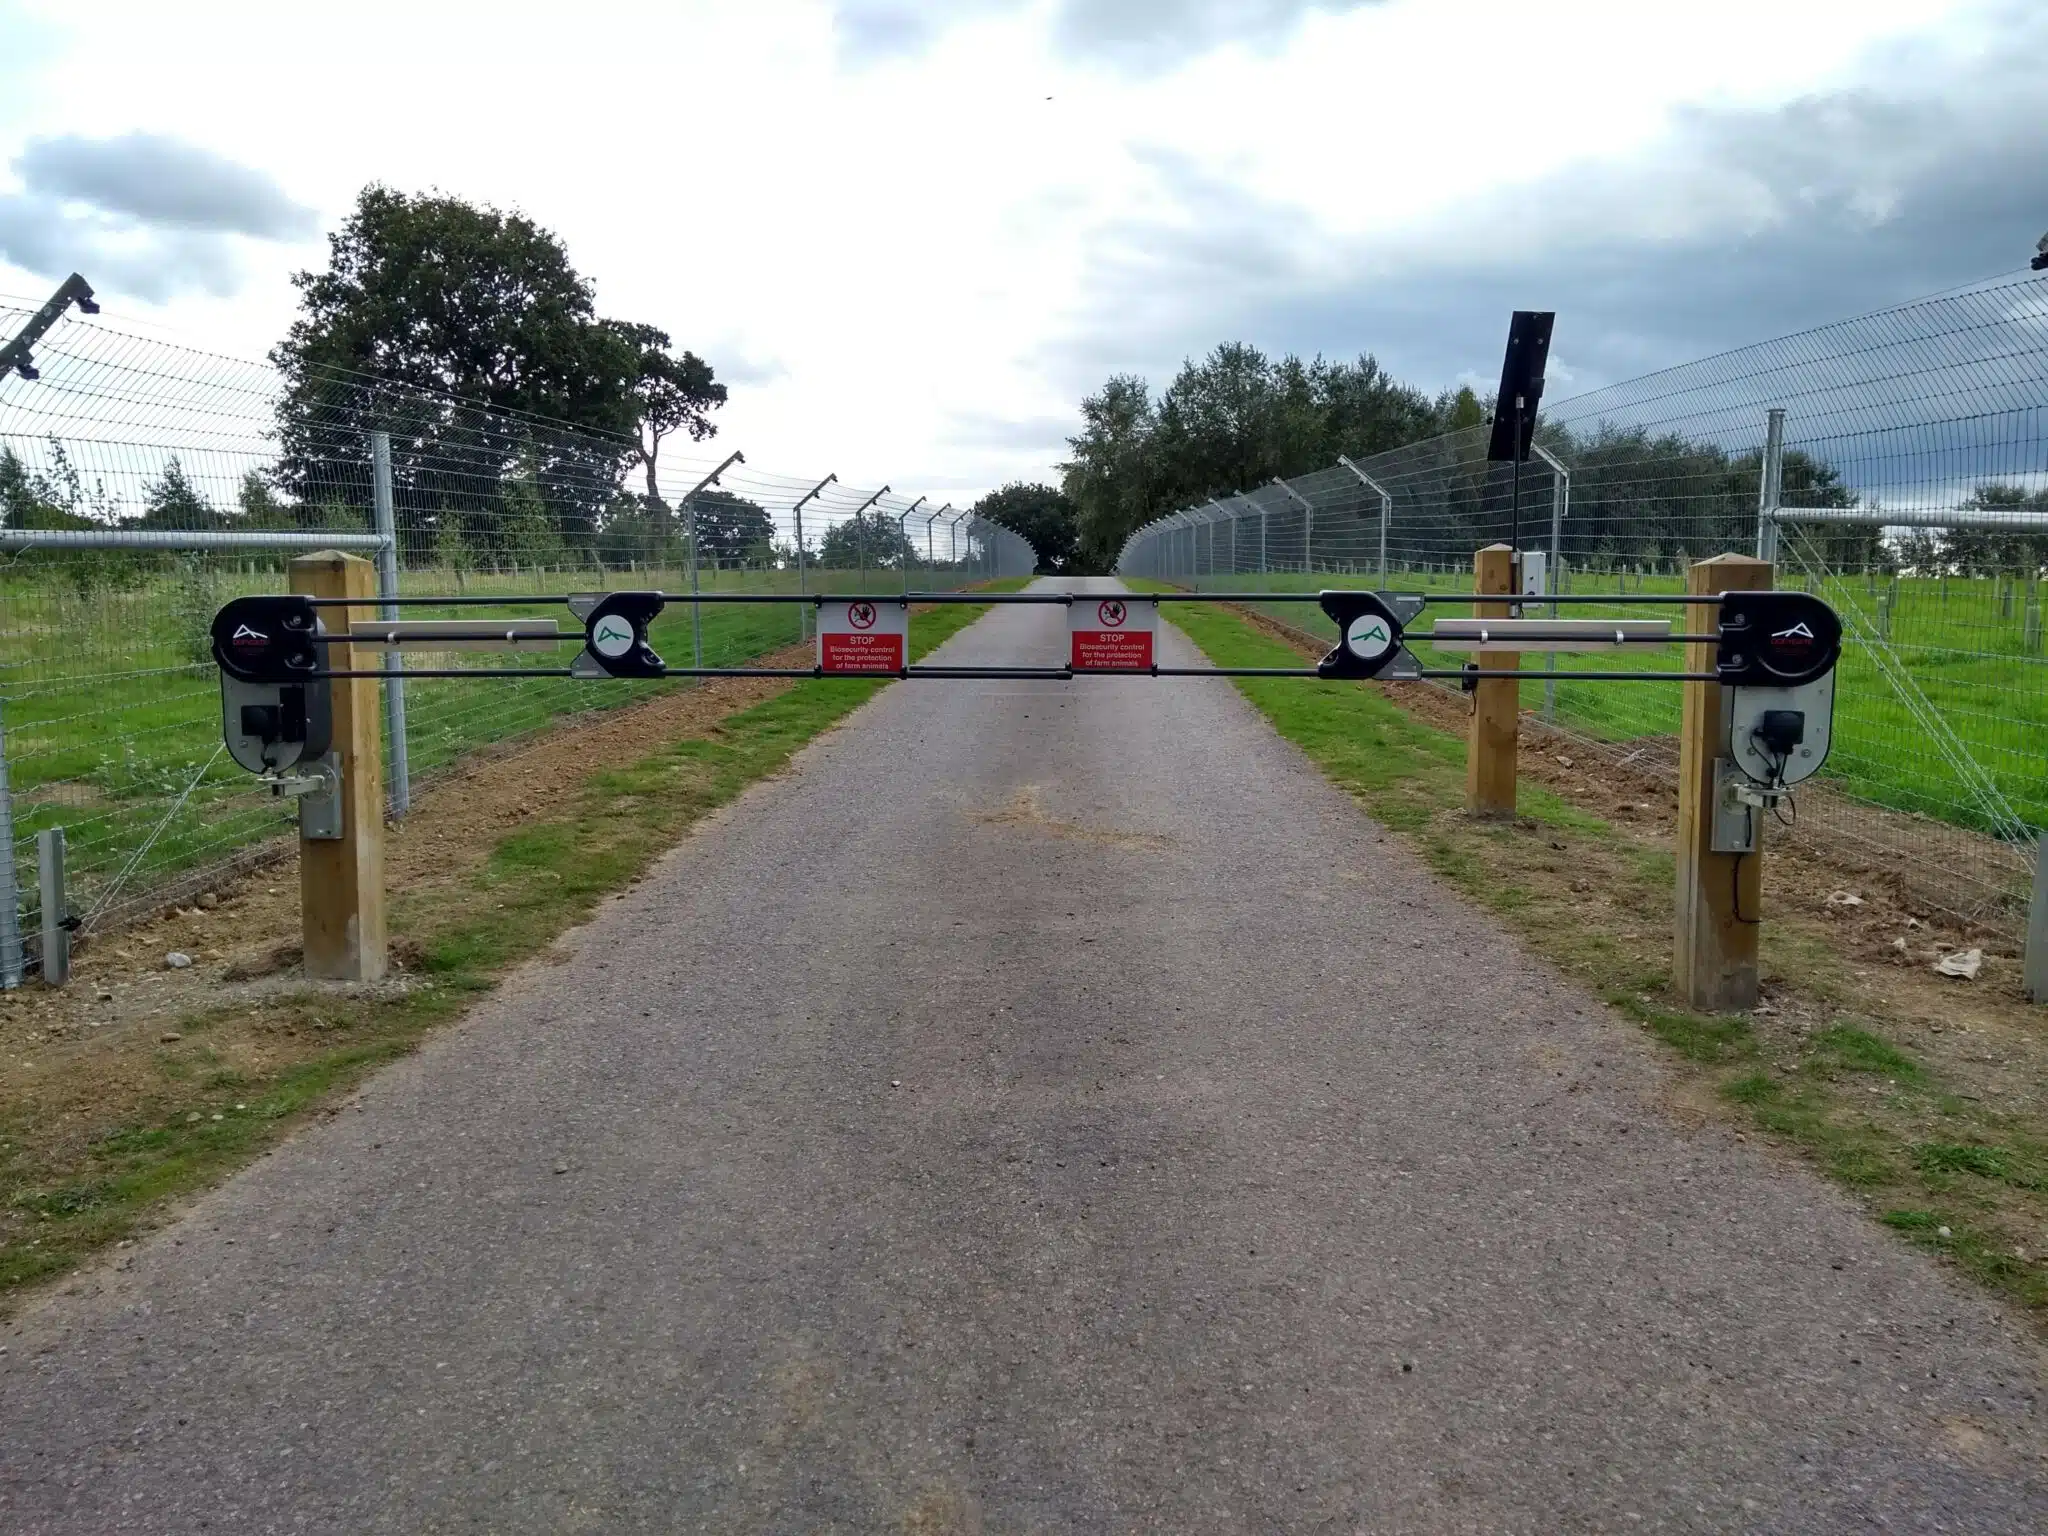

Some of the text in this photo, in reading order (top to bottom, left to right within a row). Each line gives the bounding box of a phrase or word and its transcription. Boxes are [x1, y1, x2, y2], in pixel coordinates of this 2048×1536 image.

[850, 636, 875, 645] STOP
[1099, 634, 1125, 642] STOP
[830, 645, 869, 654] Biosecurity
[1079, 643, 1119, 652] Biosecurity
[856, 654, 892, 662] protection
[1106, 651, 1142, 659] protection
[861, 662, 889, 670] animals
